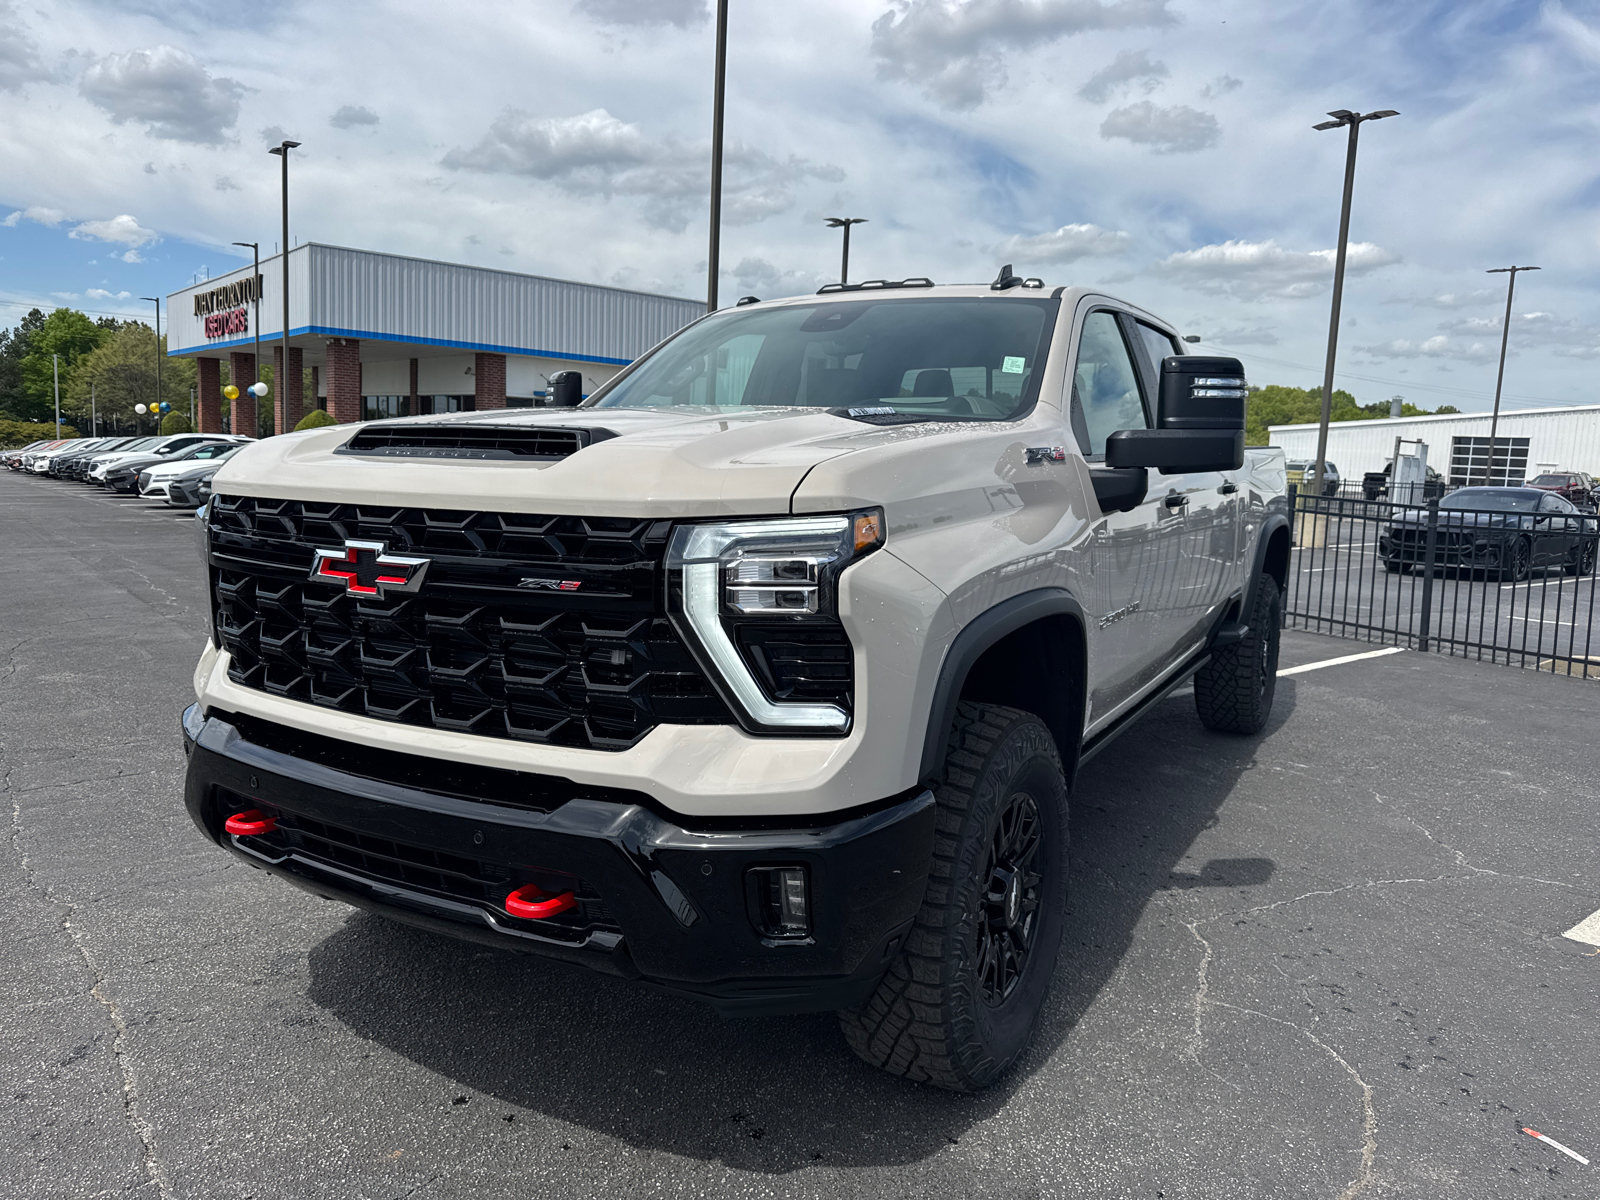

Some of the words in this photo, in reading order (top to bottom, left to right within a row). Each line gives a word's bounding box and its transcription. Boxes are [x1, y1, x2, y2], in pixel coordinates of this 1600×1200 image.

[193, 290, 214, 316] JOHN
[204, 314, 224, 339] USED
[224, 307, 246, 334] CARS
[1021, 445, 1066, 464] ZR2
[516, 577, 582, 591] ZR2
